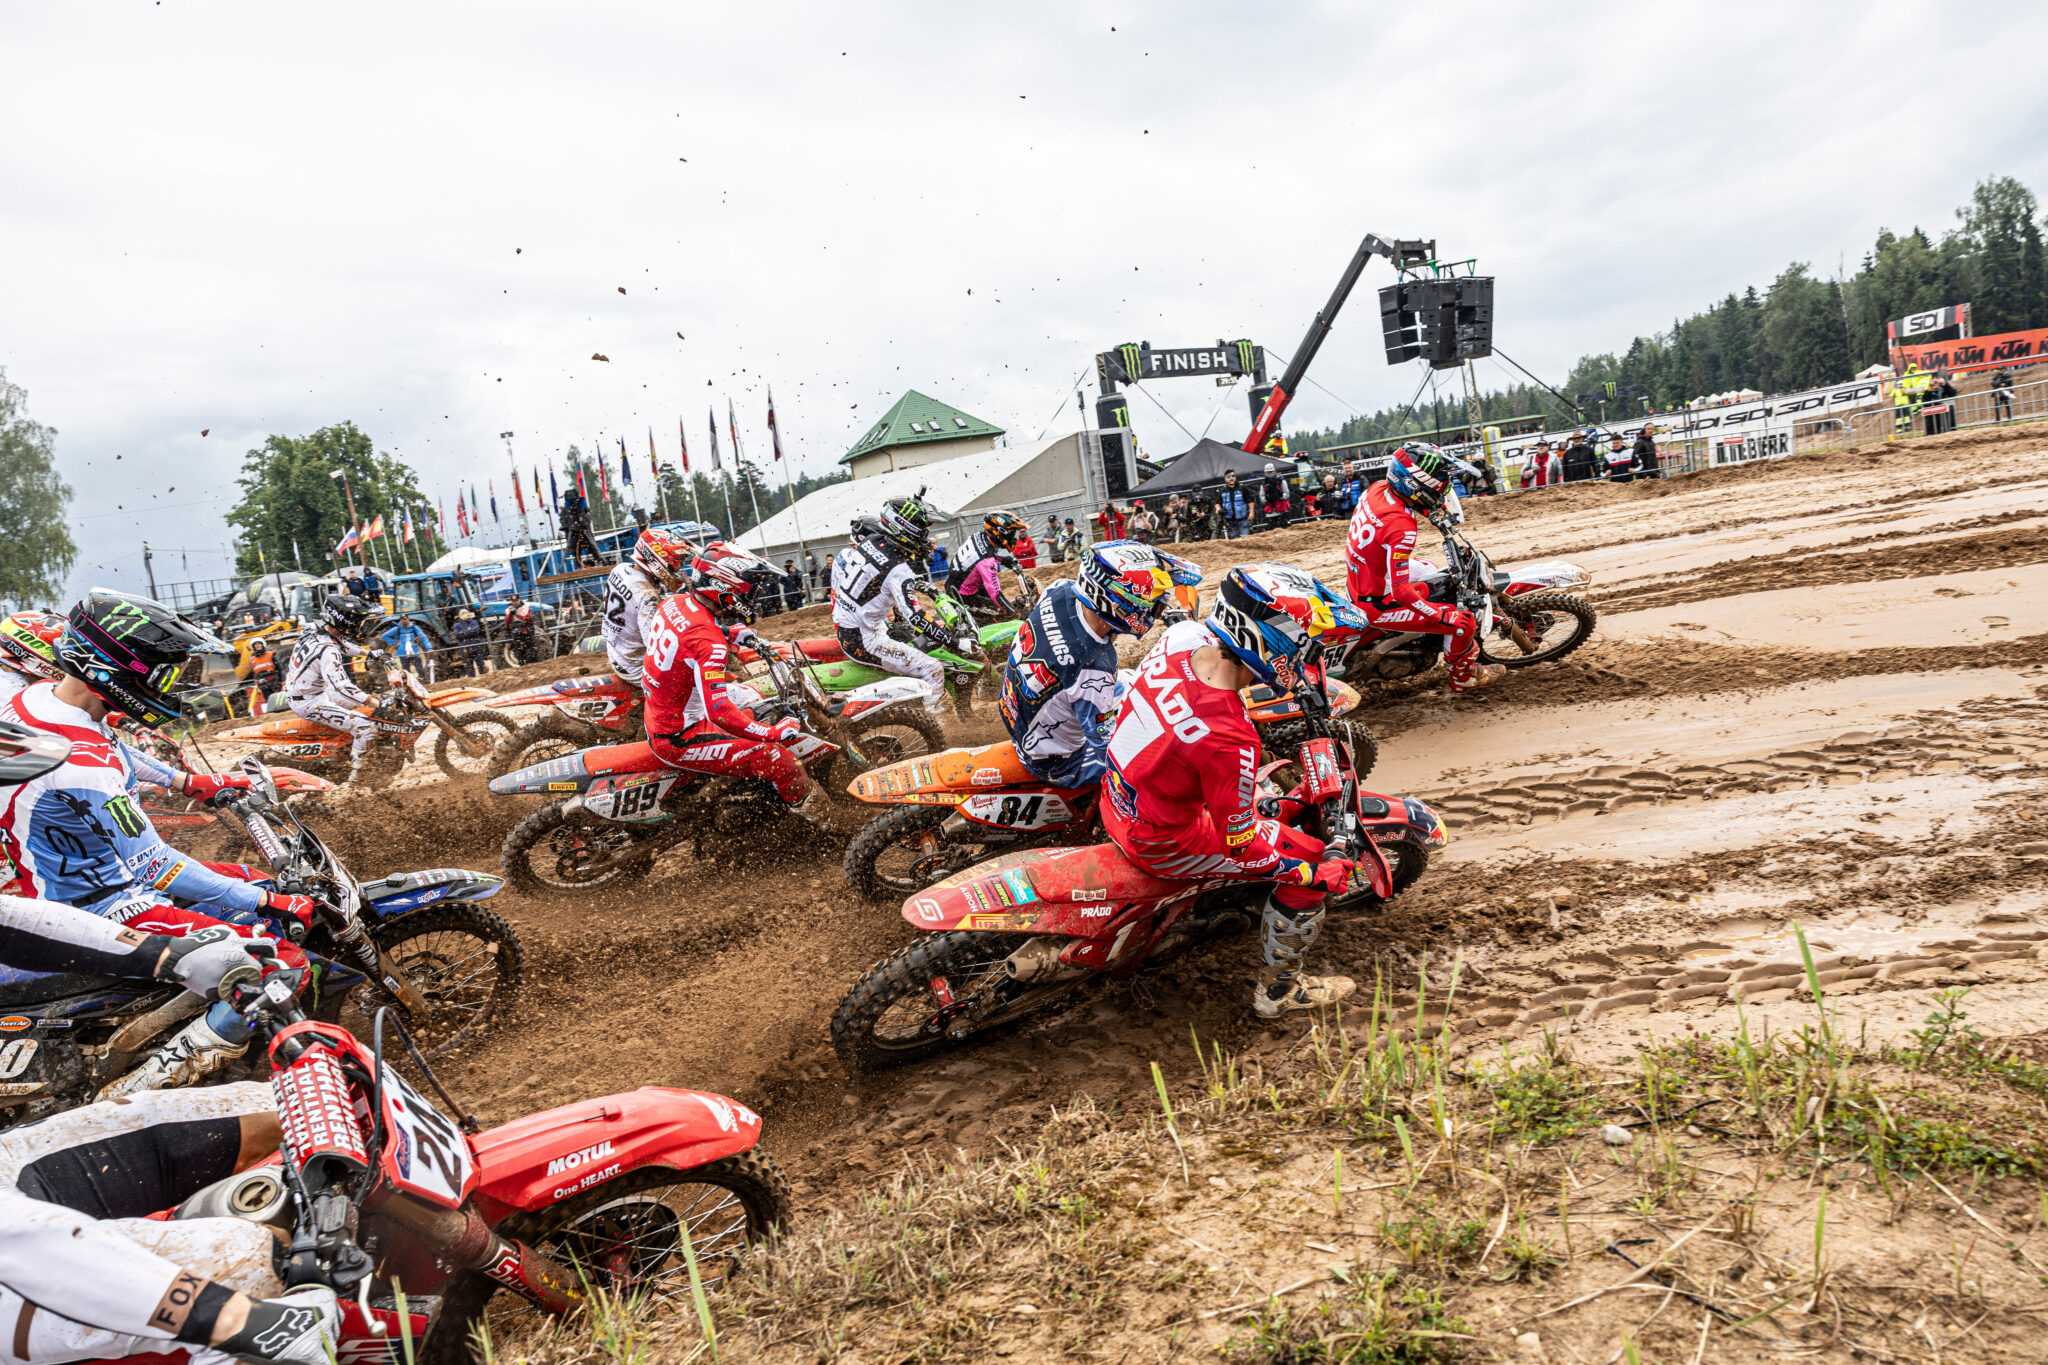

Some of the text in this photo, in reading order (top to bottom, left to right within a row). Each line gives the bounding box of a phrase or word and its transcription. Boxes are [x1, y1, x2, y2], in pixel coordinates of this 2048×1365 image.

[1151, 352, 1228, 371] FINISH
[1920, 350, 1948, 370] KTM
[1954, 346, 1986, 365] KTM
[1991, 339, 2033, 361] KTM
[1339, 611, 1365, 625] AIROH
[1411, 599, 1439, 616] SHOT
[647, 609, 680, 672] 89
[1180, 659, 1197, 682] THOR
[1323, 645, 1348, 670] 59
[106, 681, 147, 712] MONSTER
[1142, 636, 1211, 744] PRADO
[578, 702, 608, 718] 92
[1287, 703, 1301, 712] Re
[375, 723, 414, 735] ABRIEL
[292, 744, 322, 756] 326
[679, 743, 733, 761] SHOT
[550, 783, 576, 791] PIRELLI
[1238, 746, 1255, 808] THOR
[610, 782, 661, 819] 189
[996, 796, 1044, 826] 84
[248, 817, 278, 859] RENTHAL
[138, 855, 170, 884] VERTEX
[960, 886, 979, 913] AIROH
[1081, 906, 1112, 918] PRADO
[0, 1038, 39, 1079] 0
[281, 1070, 311, 1158] RENTHAL
[296, 1061, 330, 1147] RENTHAL
[310, 1048, 353, 1151] RENTHAL
[327, 1055, 368, 1158] RENTHAL
[546, 1140, 616, 1177] MOTUL
[553, 1163, 622, 1199] One HEART.
[156, 1272, 203, 1327] FOX
